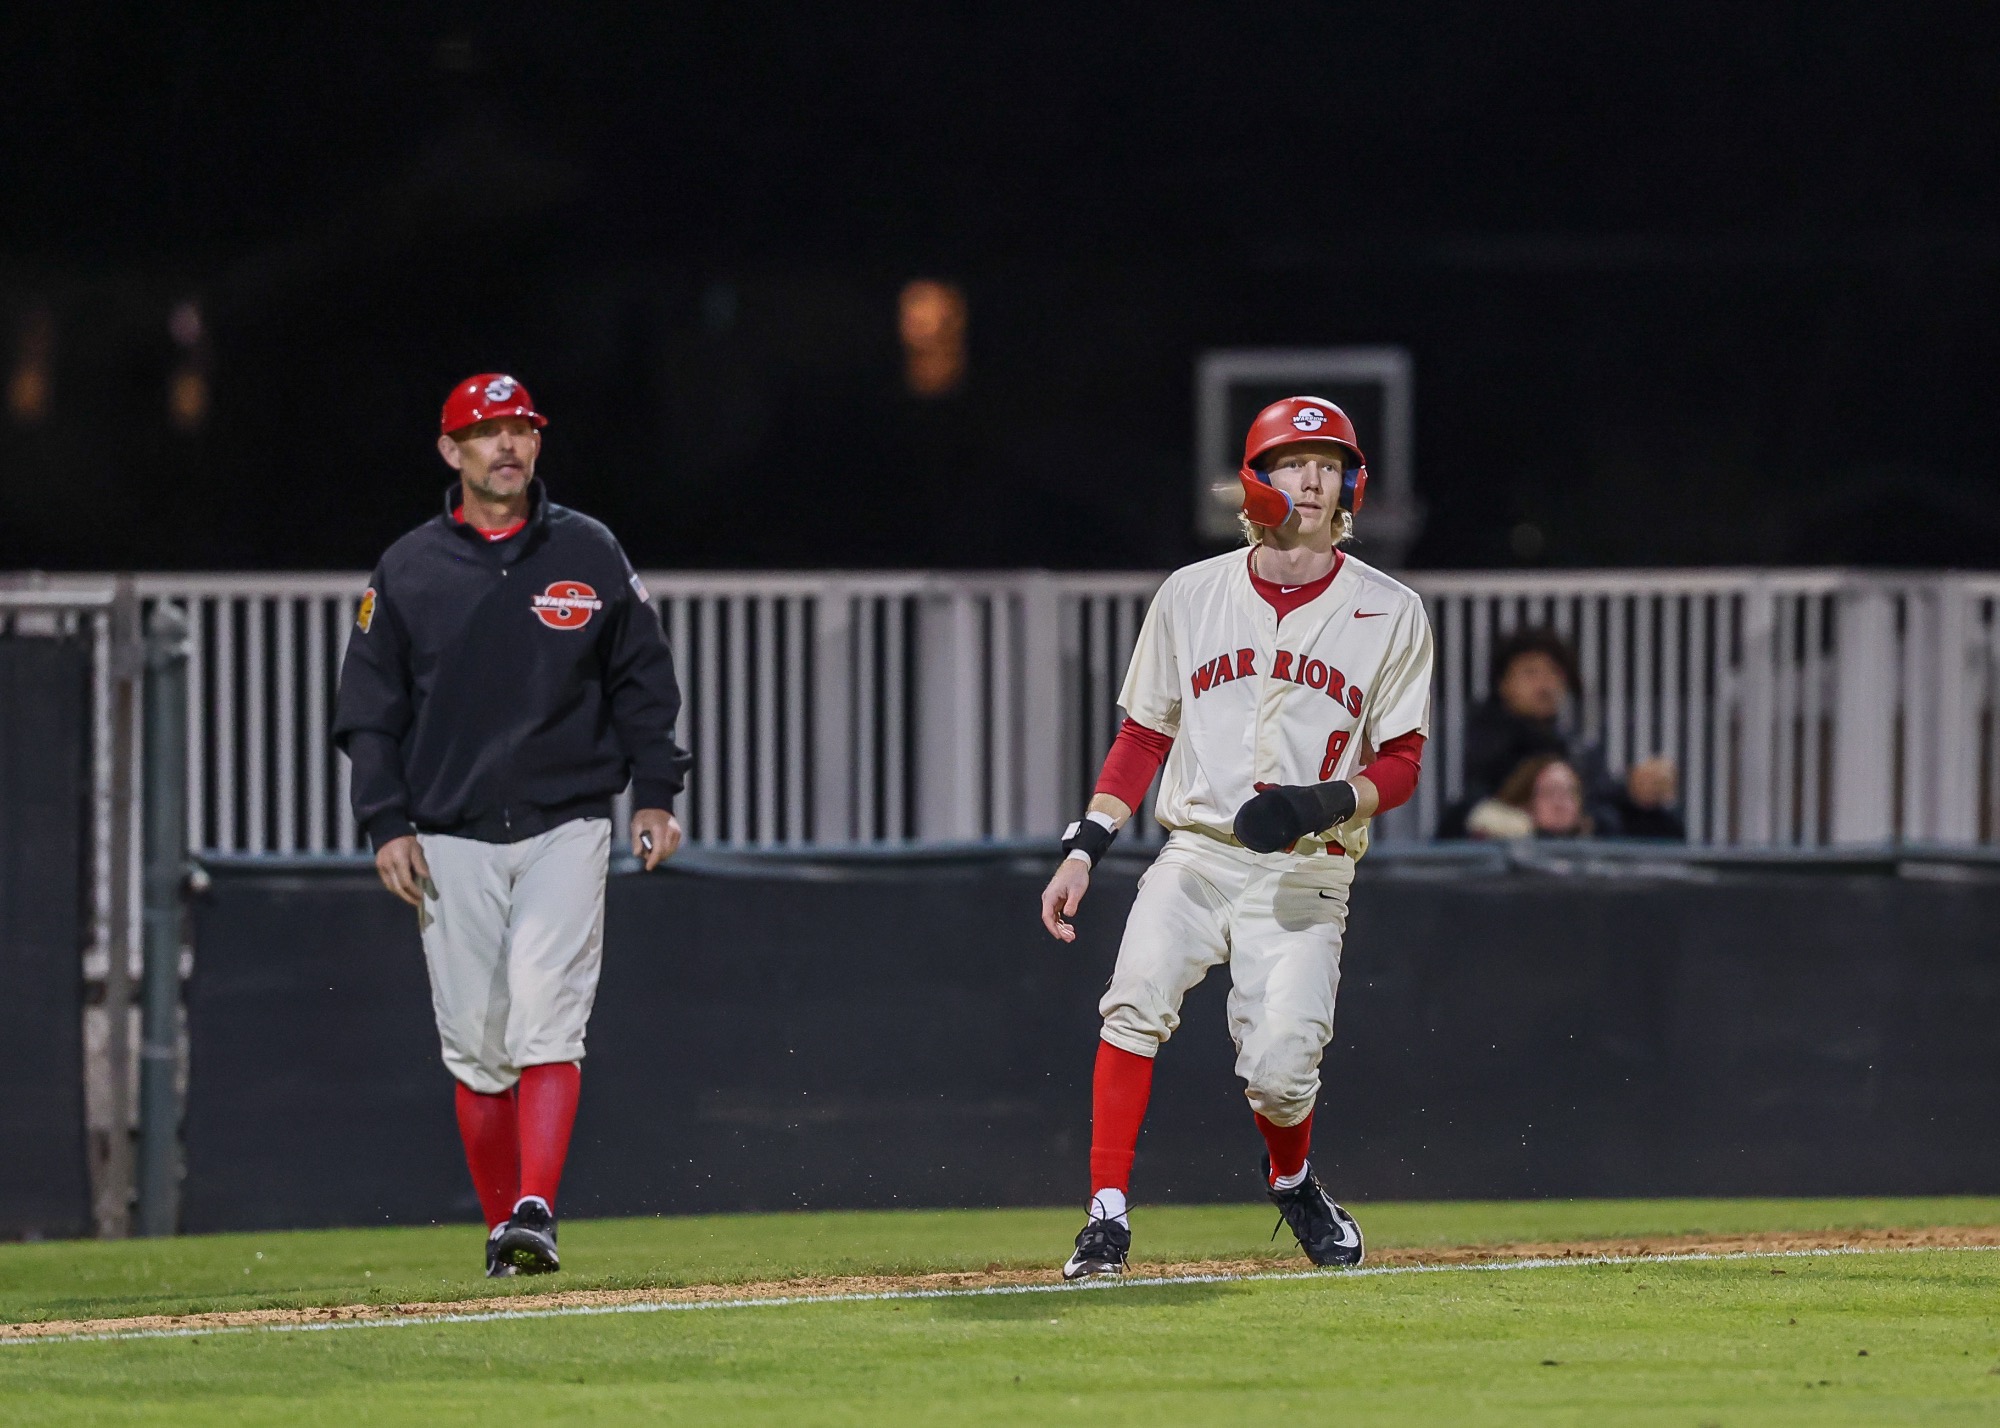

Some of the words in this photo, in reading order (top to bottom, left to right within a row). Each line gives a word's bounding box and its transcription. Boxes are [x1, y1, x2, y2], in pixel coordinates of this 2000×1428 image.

[1293, 407, 1324, 432] S
[531, 580, 597, 630] S
[1319, 730, 1350, 781] 8
